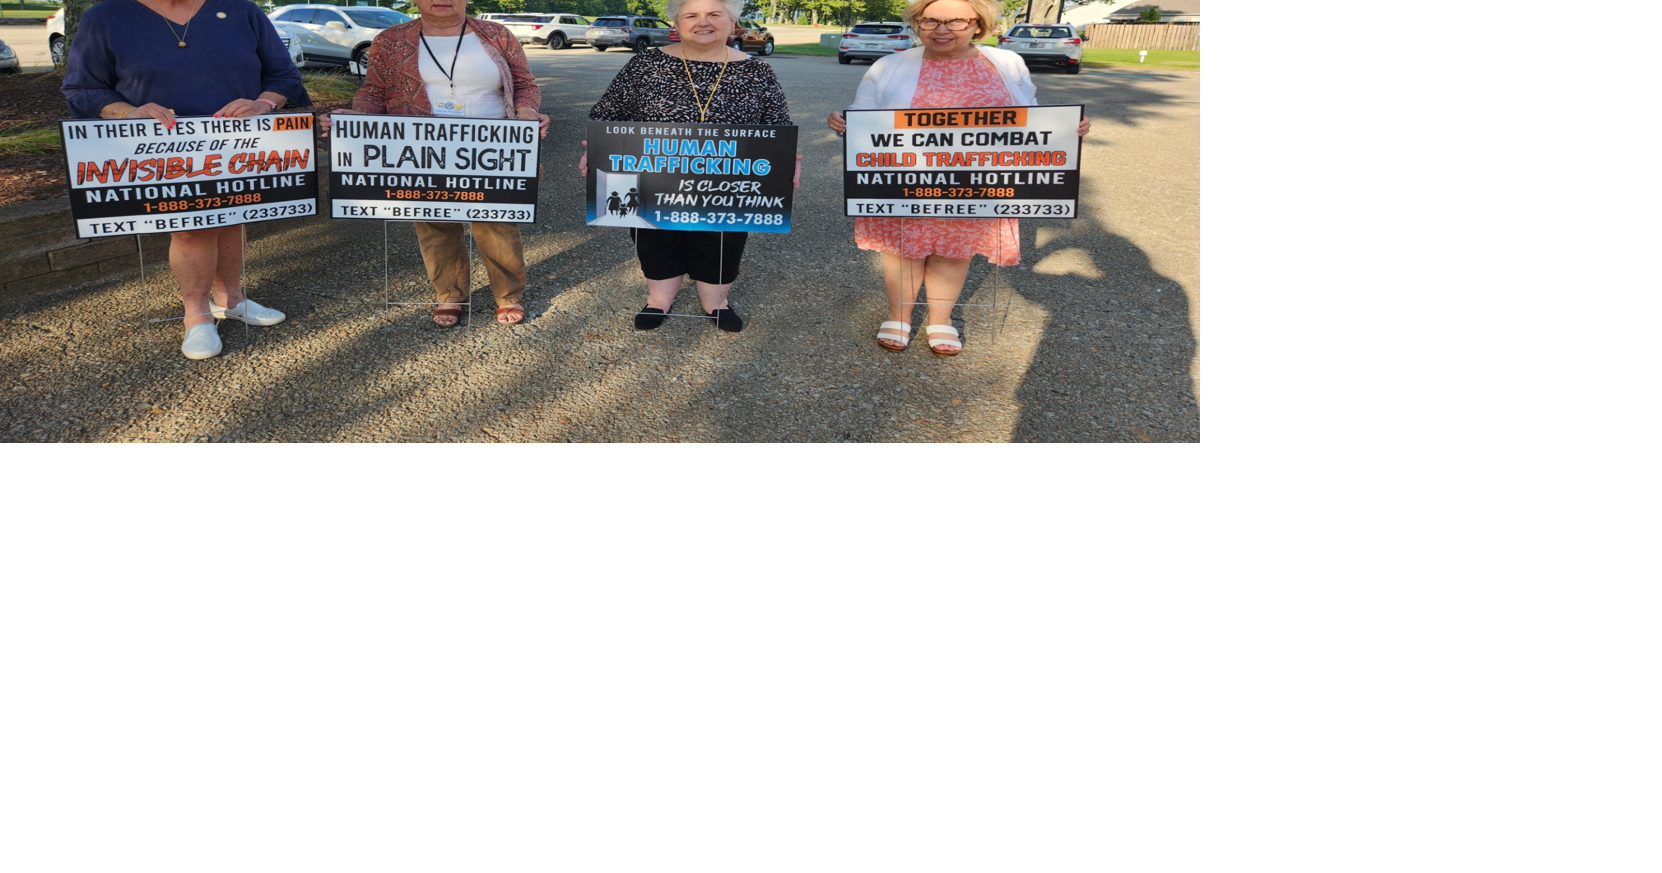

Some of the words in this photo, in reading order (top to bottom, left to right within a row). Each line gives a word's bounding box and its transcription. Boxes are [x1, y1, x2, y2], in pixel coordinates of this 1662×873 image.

[904, 111, 1017, 126] TOGETHER
[68, 125, 88, 140] IN
[94, 123, 147, 138] THEIR
[201, 118, 251, 134] THERE
[257, 118, 271, 131] IS
[276, 116, 309, 131] PAIN
[336, 120, 405, 140] HUMAN
[412, 123, 534, 144] TRAFFICKING
[606, 126, 635, 135] LOOK
[640, 127, 692, 136] BENEATH
[698, 129, 719, 137] THE
[724, 129, 776, 138] SURFACE
[134, 140, 206, 155] BECAUSE
[209, 139, 229, 151] OF
[232, 138, 260, 149] THE
[644, 138, 737, 156] HUMAN
[871, 134, 904, 147] WE
[912, 133, 954, 147] CAN
[961, 131, 1052, 146] COMBAT
[338, 152, 352, 167] IN
[364, 145, 446, 169] PLAIN
[454, 147, 531, 171] SIGHT
[609, 155, 771, 175] TRAFFICKING
[856, 152, 917, 167] CHILD
[923, 151, 1067, 167] TRAFFICKING
[76, 154, 222, 185] INVISIBLE
[228, 149, 310, 174] CHAIN
[341, 174, 437, 188] NATIONAL
[446, 177, 527, 190] HOTLINE
[679, 179, 695, 191] IS
[697, 180, 762, 194] CLOSER
[857, 173, 960, 185] NATIONAL
[970, 172, 1065, 185] HOTLINE
[86, 184, 207, 203] NATIONAL
[217, 174, 306, 194] HOTLINE
[385, 190, 484, 201] 1-888-373-7888
[902, 188, 1015, 197] 1-888-373-7888
[144, 193, 261, 212] 1-888-373-7888
[655, 193, 698, 207] THAN
[701, 194, 734, 207] YOU
[736, 194, 785, 208] THINK
[341, 206, 378, 216] TEXT
[466, 209, 531, 220] (233733)
[654, 210, 783, 225] 1-888-373-7888
[856, 203, 895, 214] TEXT
[993, 203, 1070, 216] (233733)
[90, 221, 137, 234] TEXT
[243, 203, 313, 220] (233733)
